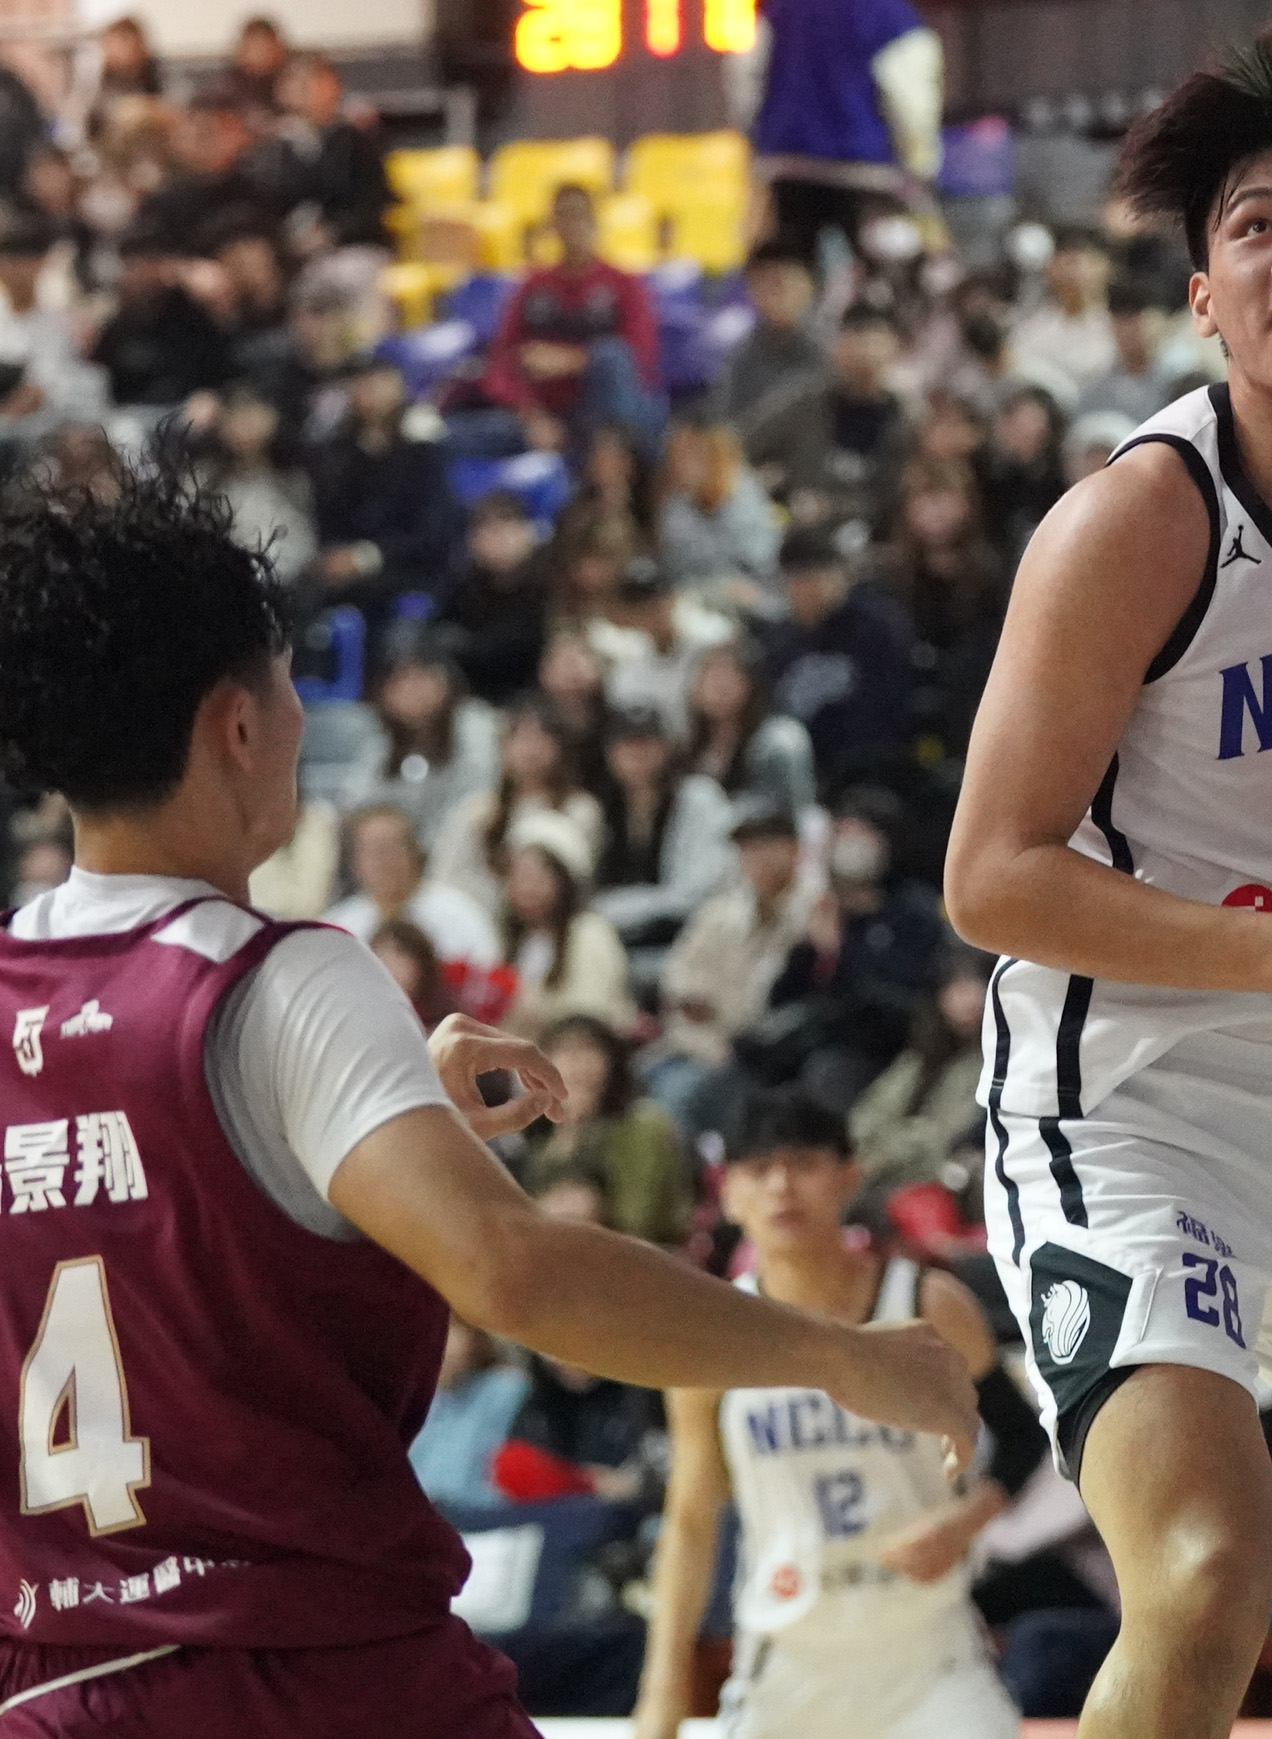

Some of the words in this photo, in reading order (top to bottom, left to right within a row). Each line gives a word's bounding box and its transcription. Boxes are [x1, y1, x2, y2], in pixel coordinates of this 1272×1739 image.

[0, 1110, 149, 1215] 景翔
[1182, 1252, 1246, 1350] 28
[19, 1255, 150, 1537] 4
